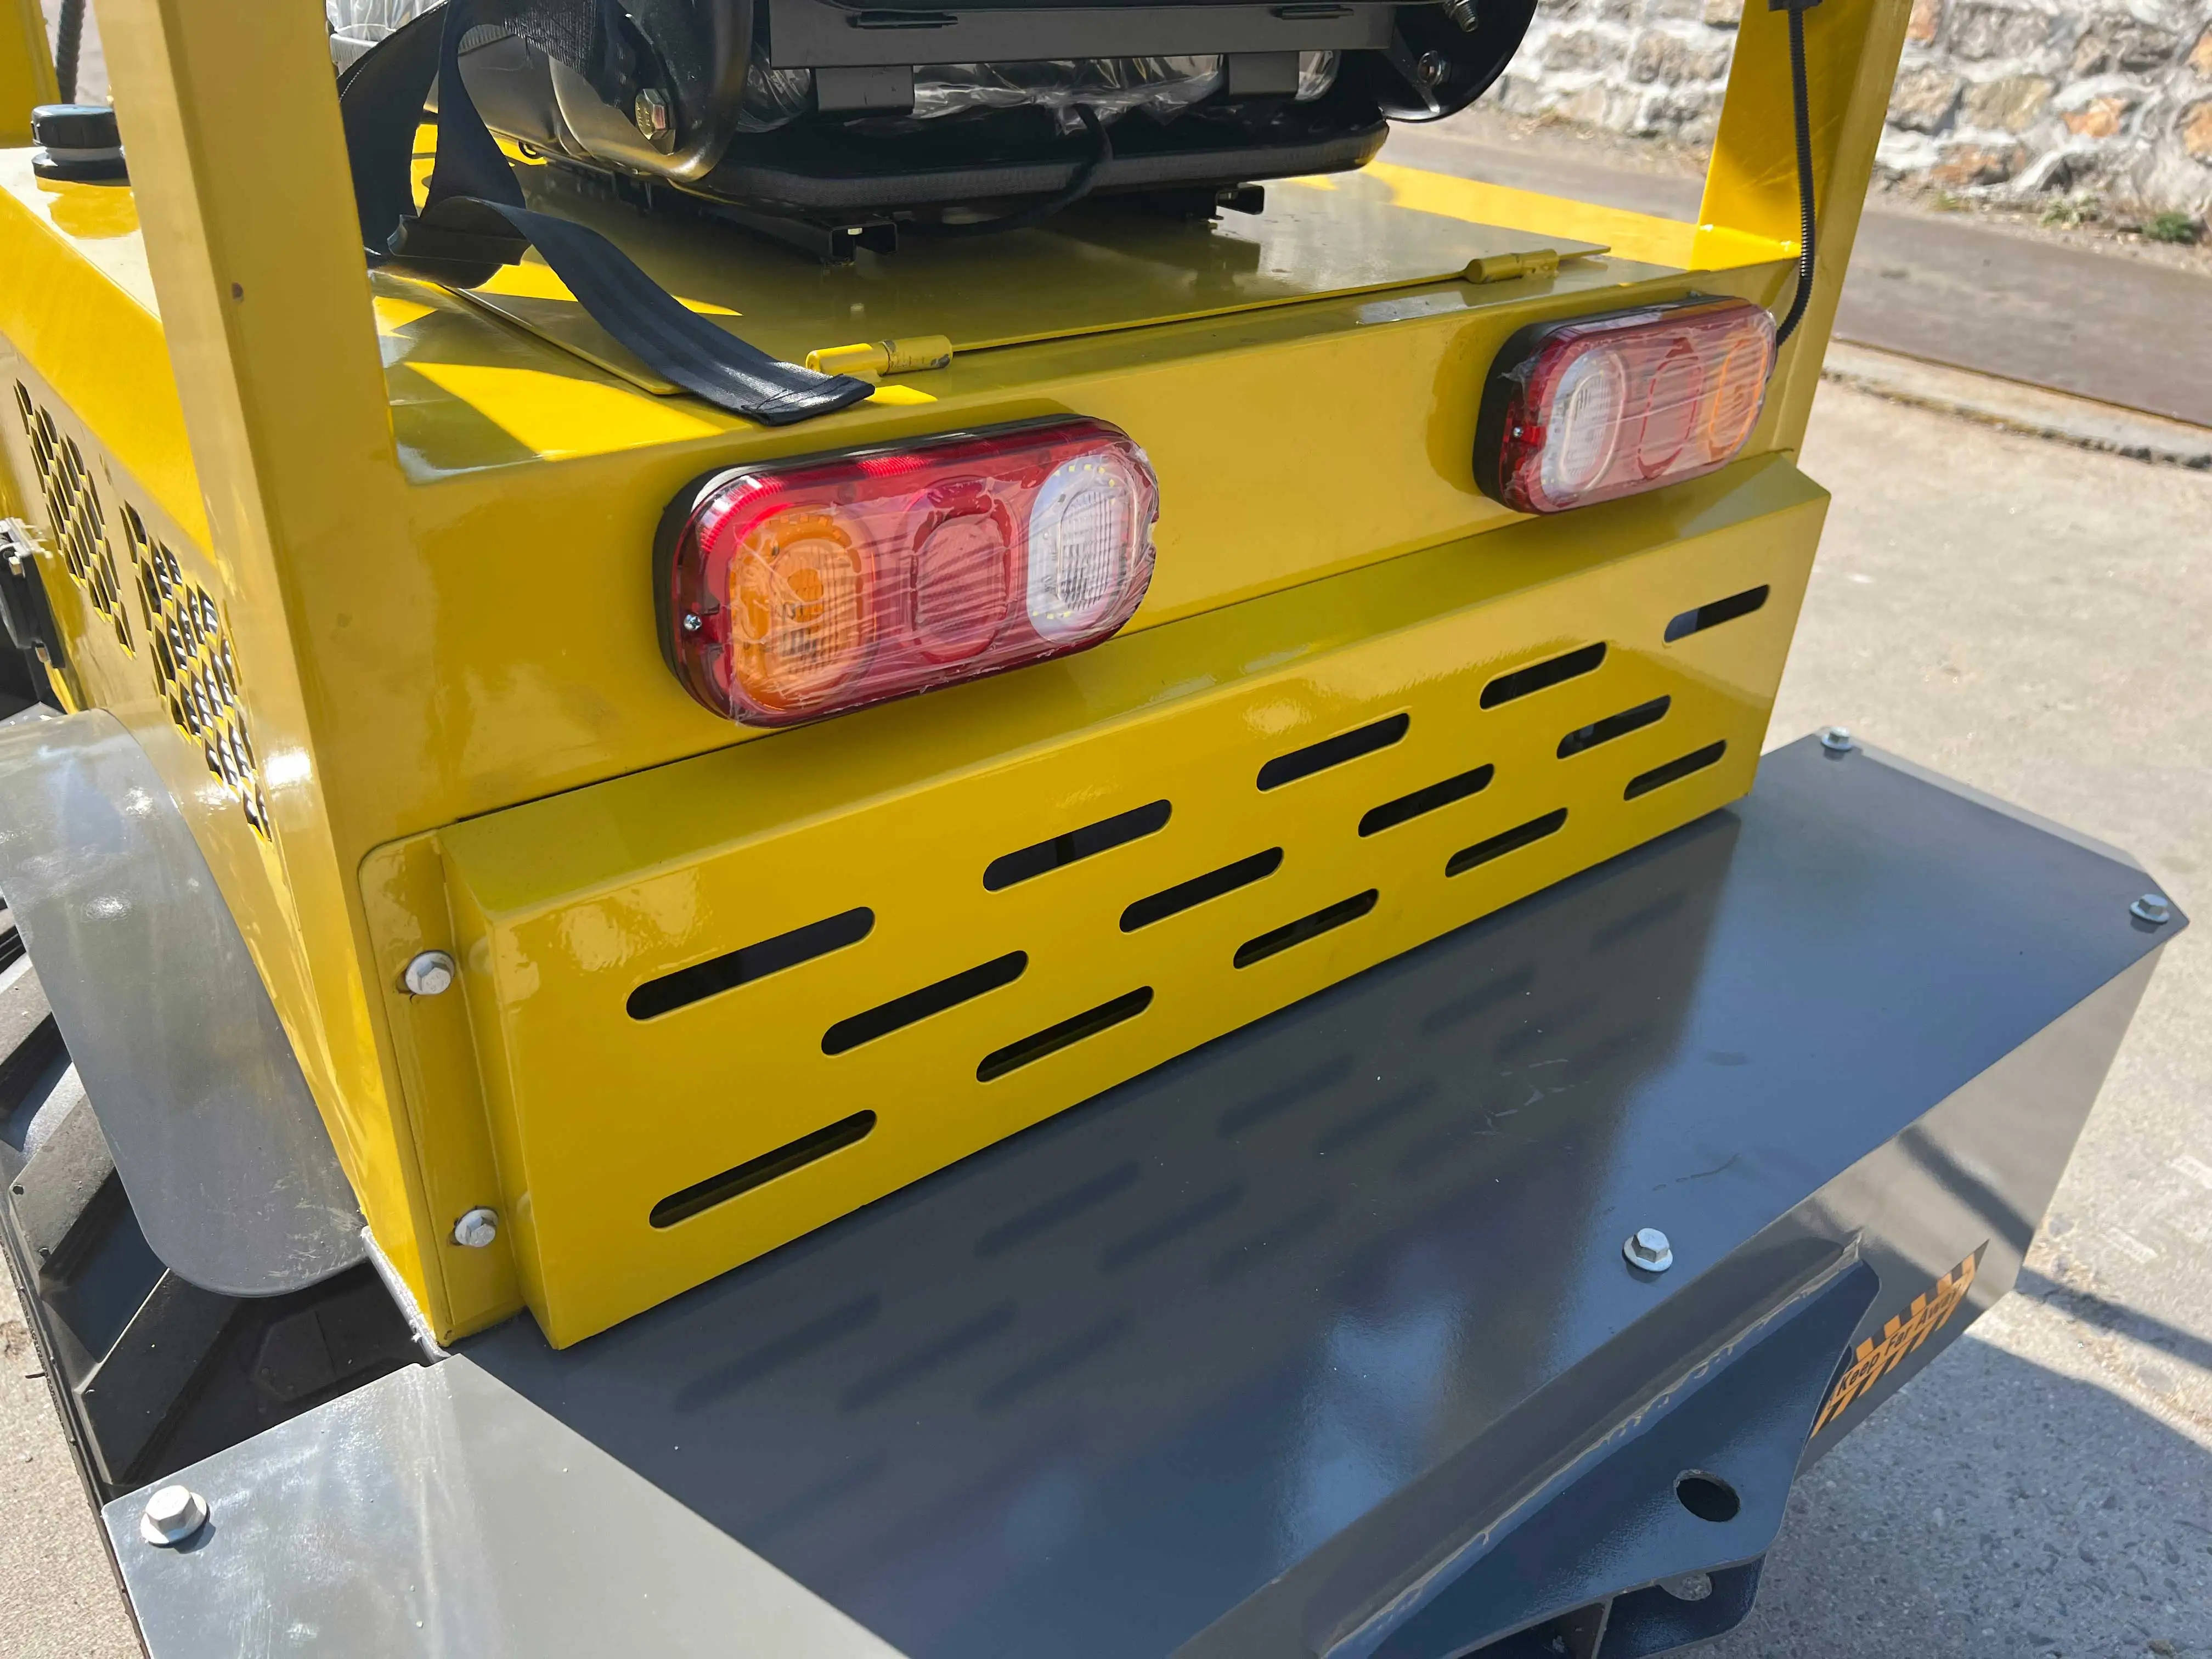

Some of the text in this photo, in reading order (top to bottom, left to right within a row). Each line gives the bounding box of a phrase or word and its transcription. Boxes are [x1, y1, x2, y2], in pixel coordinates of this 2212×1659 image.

[1836, 1283, 1962, 1397] Keep Far Away
